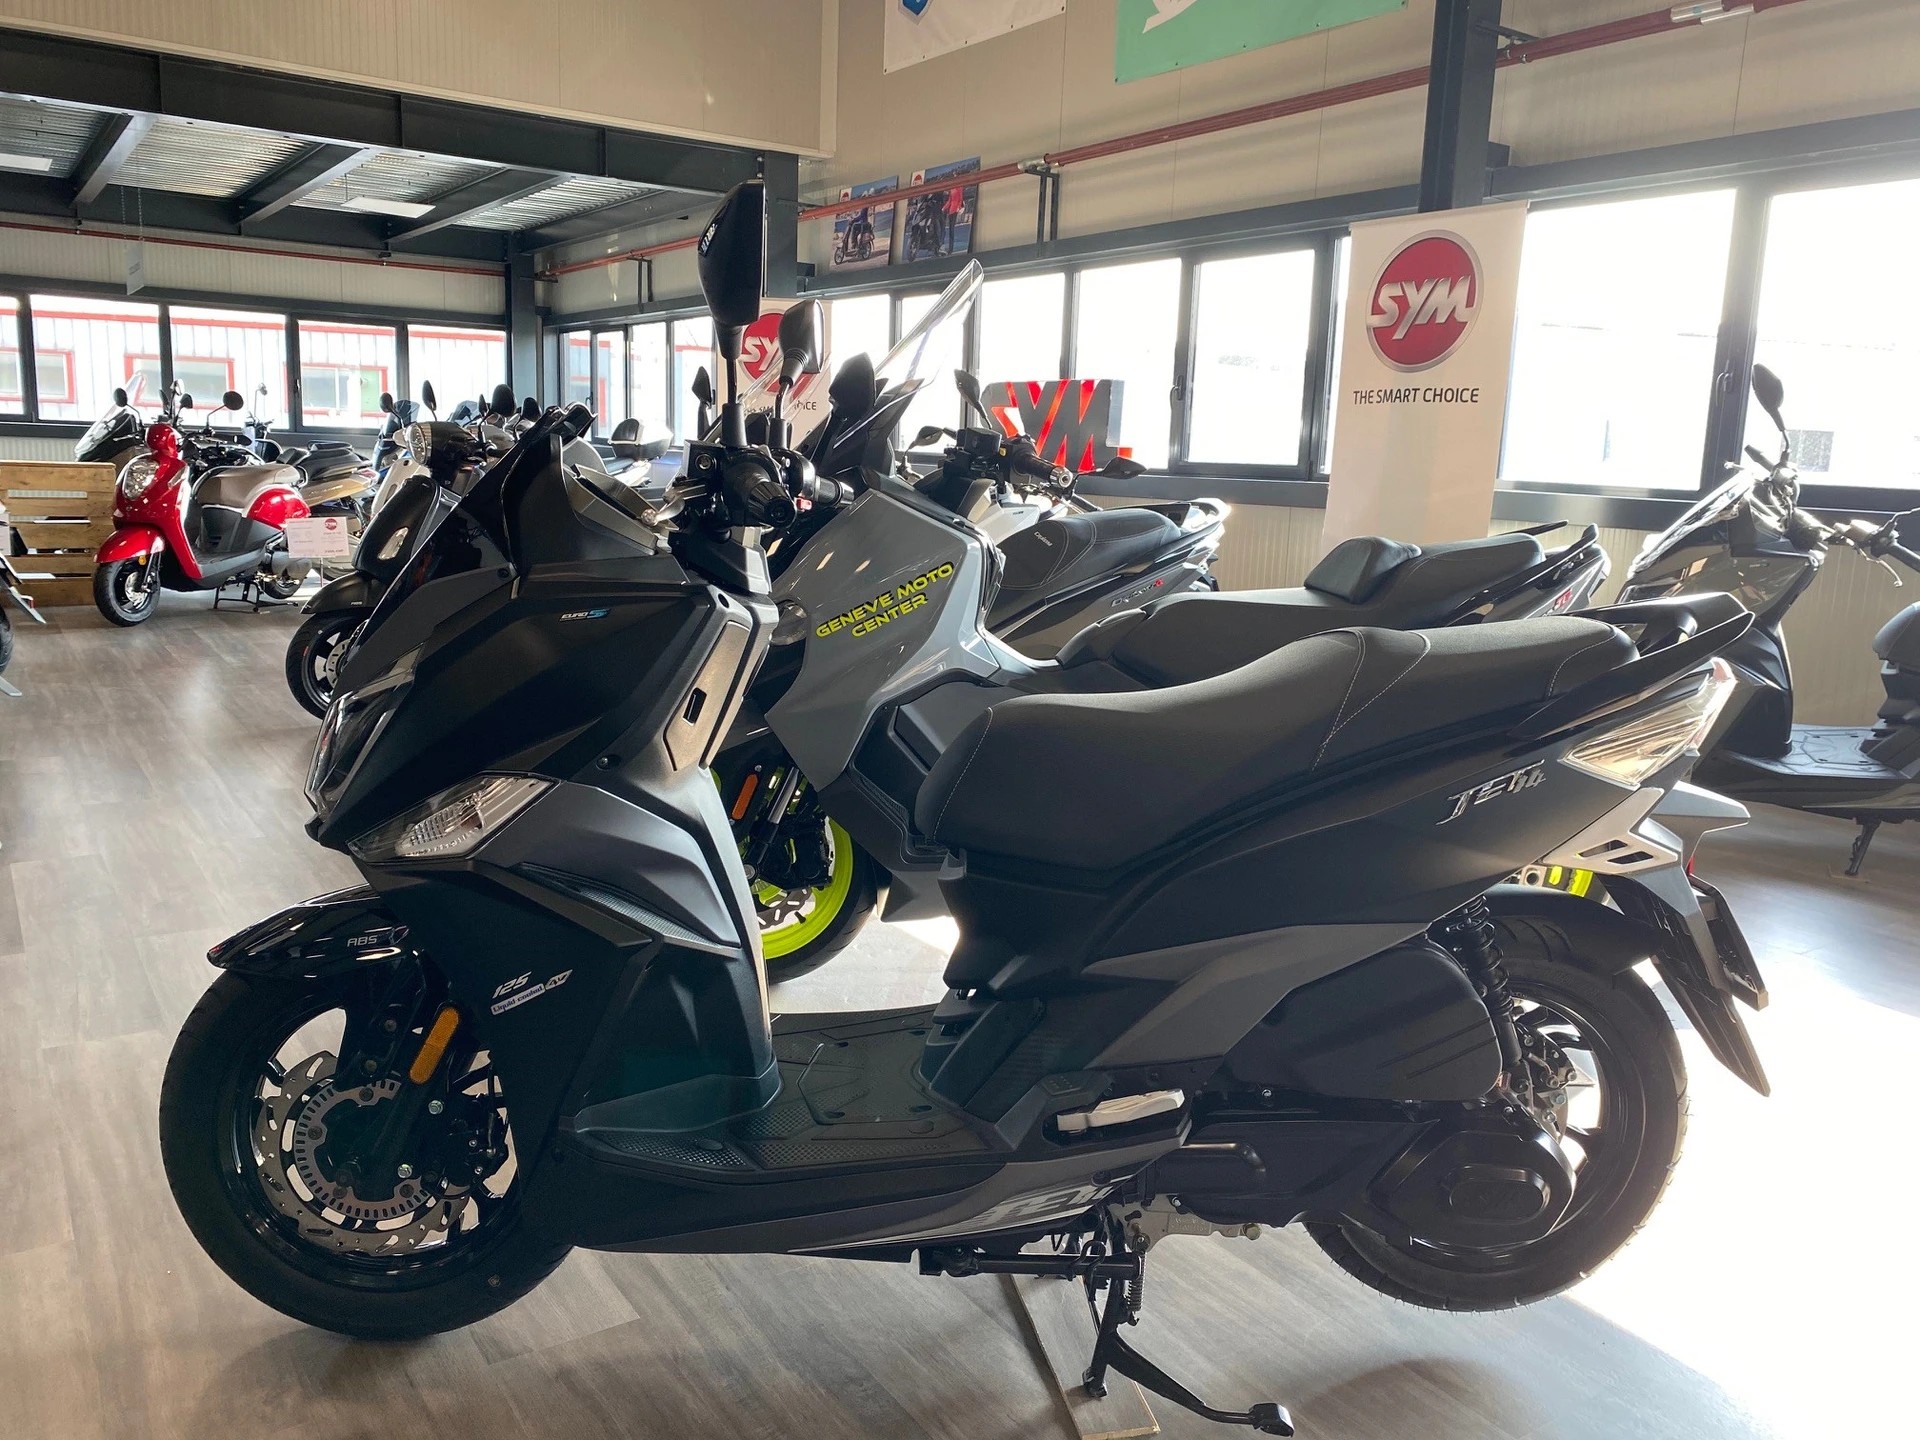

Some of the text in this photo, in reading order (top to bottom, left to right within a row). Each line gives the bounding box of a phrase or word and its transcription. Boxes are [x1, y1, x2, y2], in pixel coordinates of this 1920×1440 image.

[1366, 275, 1476, 340] SYM
[740, 336, 780, 371] SY
[1353, 388, 1480, 405] THE SMART CHOICE
[815, 561, 955, 638] GENEVE MOTO
[851, 592, 928, 638] CENTER
[347, 935, 379, 947] ABS
[492, 971, 532, 999] 125
